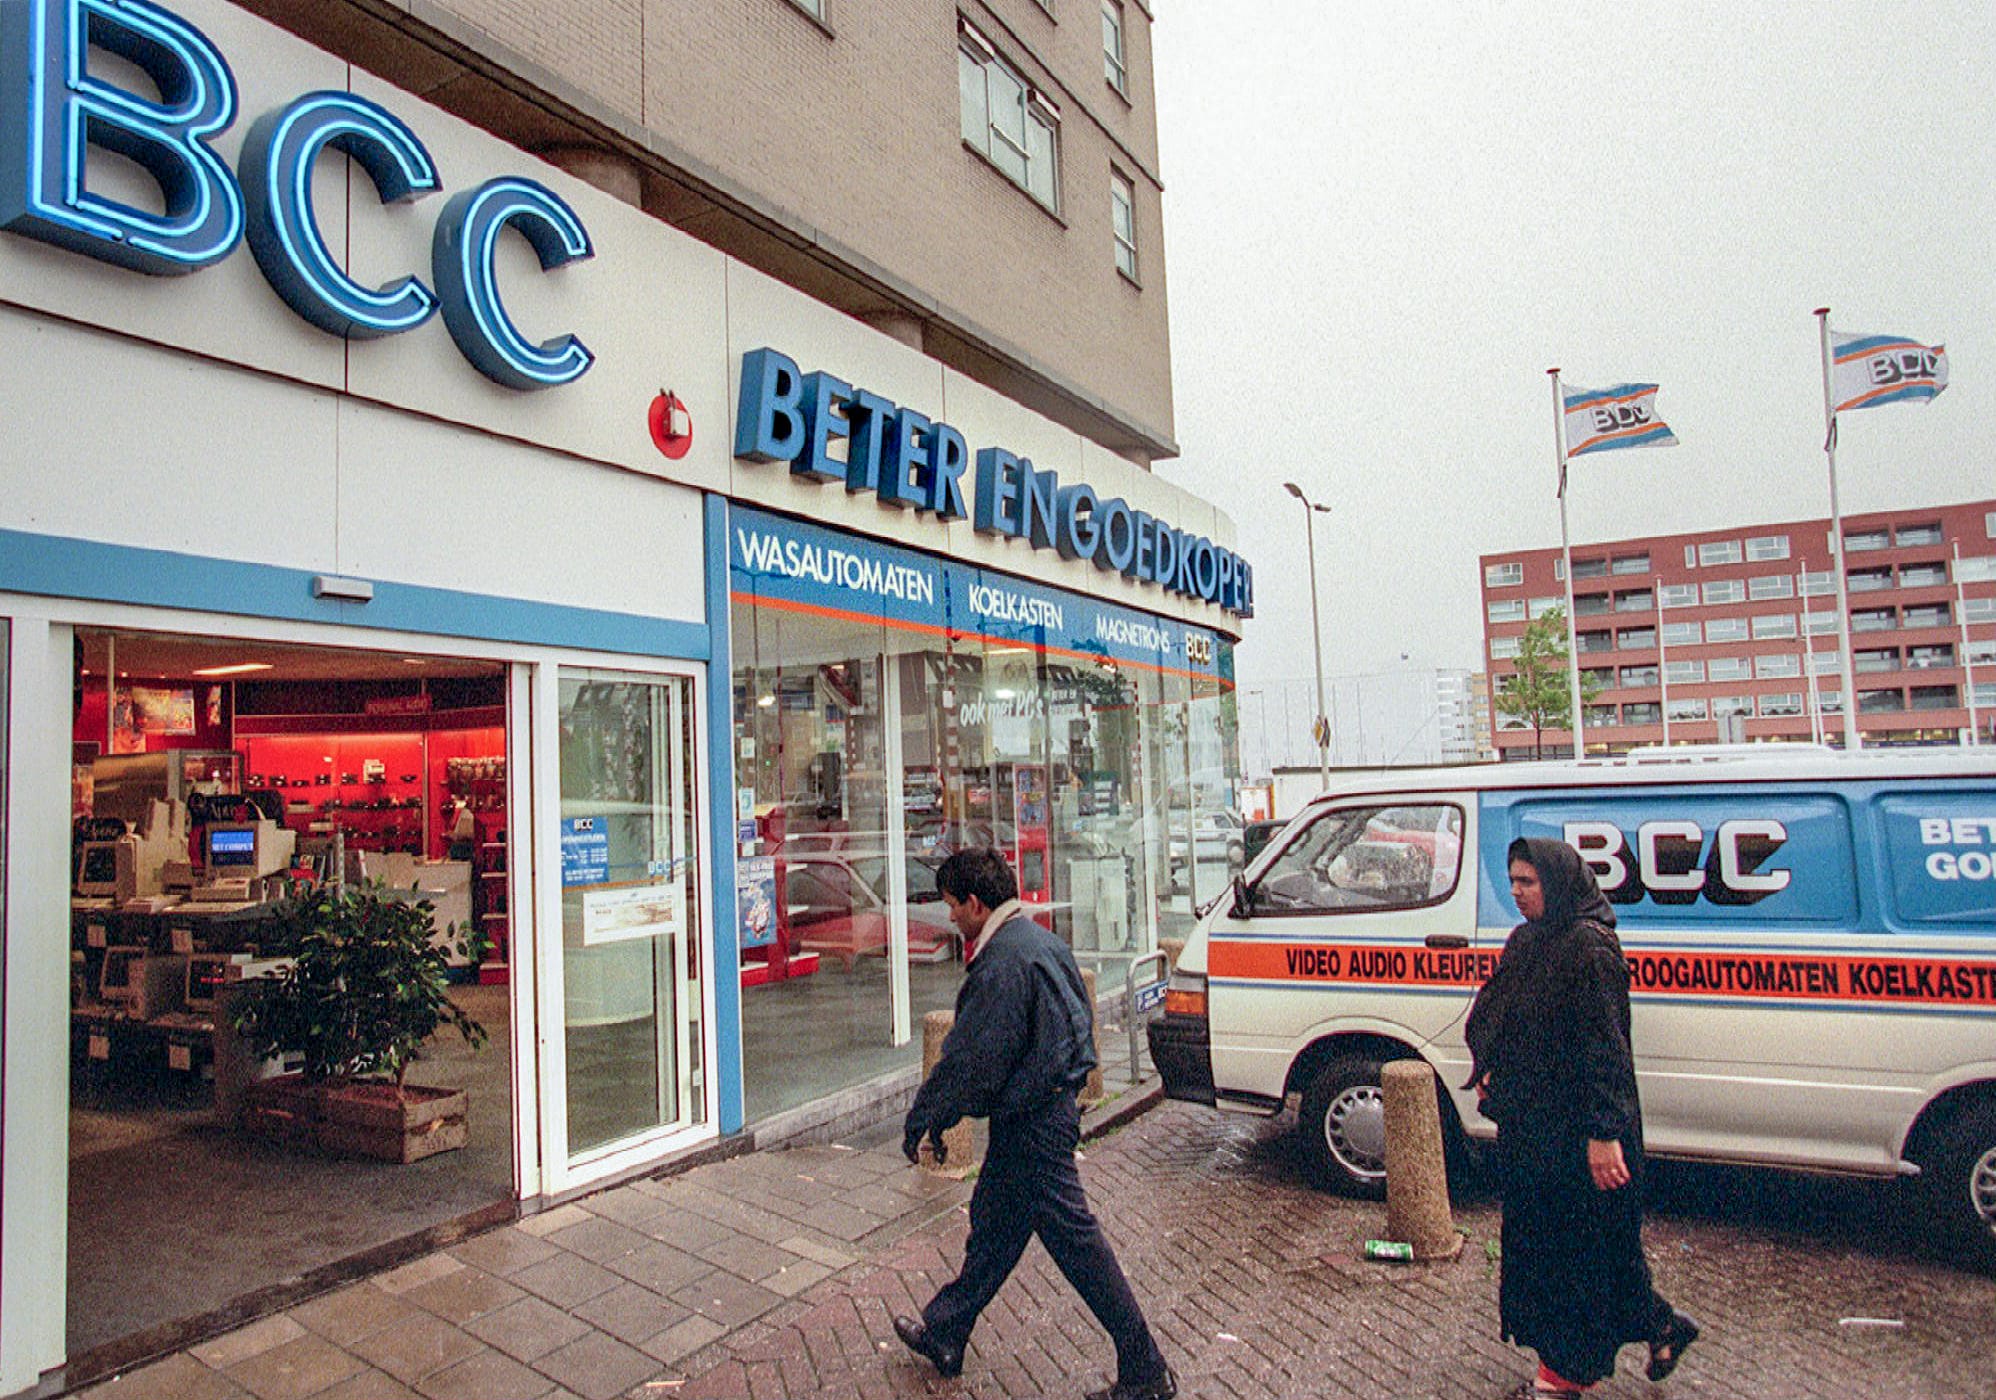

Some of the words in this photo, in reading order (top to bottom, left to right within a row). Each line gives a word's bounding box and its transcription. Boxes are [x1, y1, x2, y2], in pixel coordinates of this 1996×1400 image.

[0, 0, 595, 391] BCC
[734, 346, 968, 521] BETER
[973, 446, 1058, 551] EN
[737, 527, 934, 605] WASAUTOMATEN
[969, 584, 1063, 631] KOELKASTEN
[1095, 614, 1171, 653] MAGNETRONS
[1185, 631, 1212, 662] BCC
[959, 691, 986, 727] ook
[573, 818, 593, 831] BCC
[1562, 819, 1792, 905] BCC
[1925, 851, 1996, 880] GO
[1286, 948, 1340, 976] VIDEO
[1349, 950, 1406, 978] AUDIO
[1626, 957, 1838, 993] ROOGAUTOMATEN
